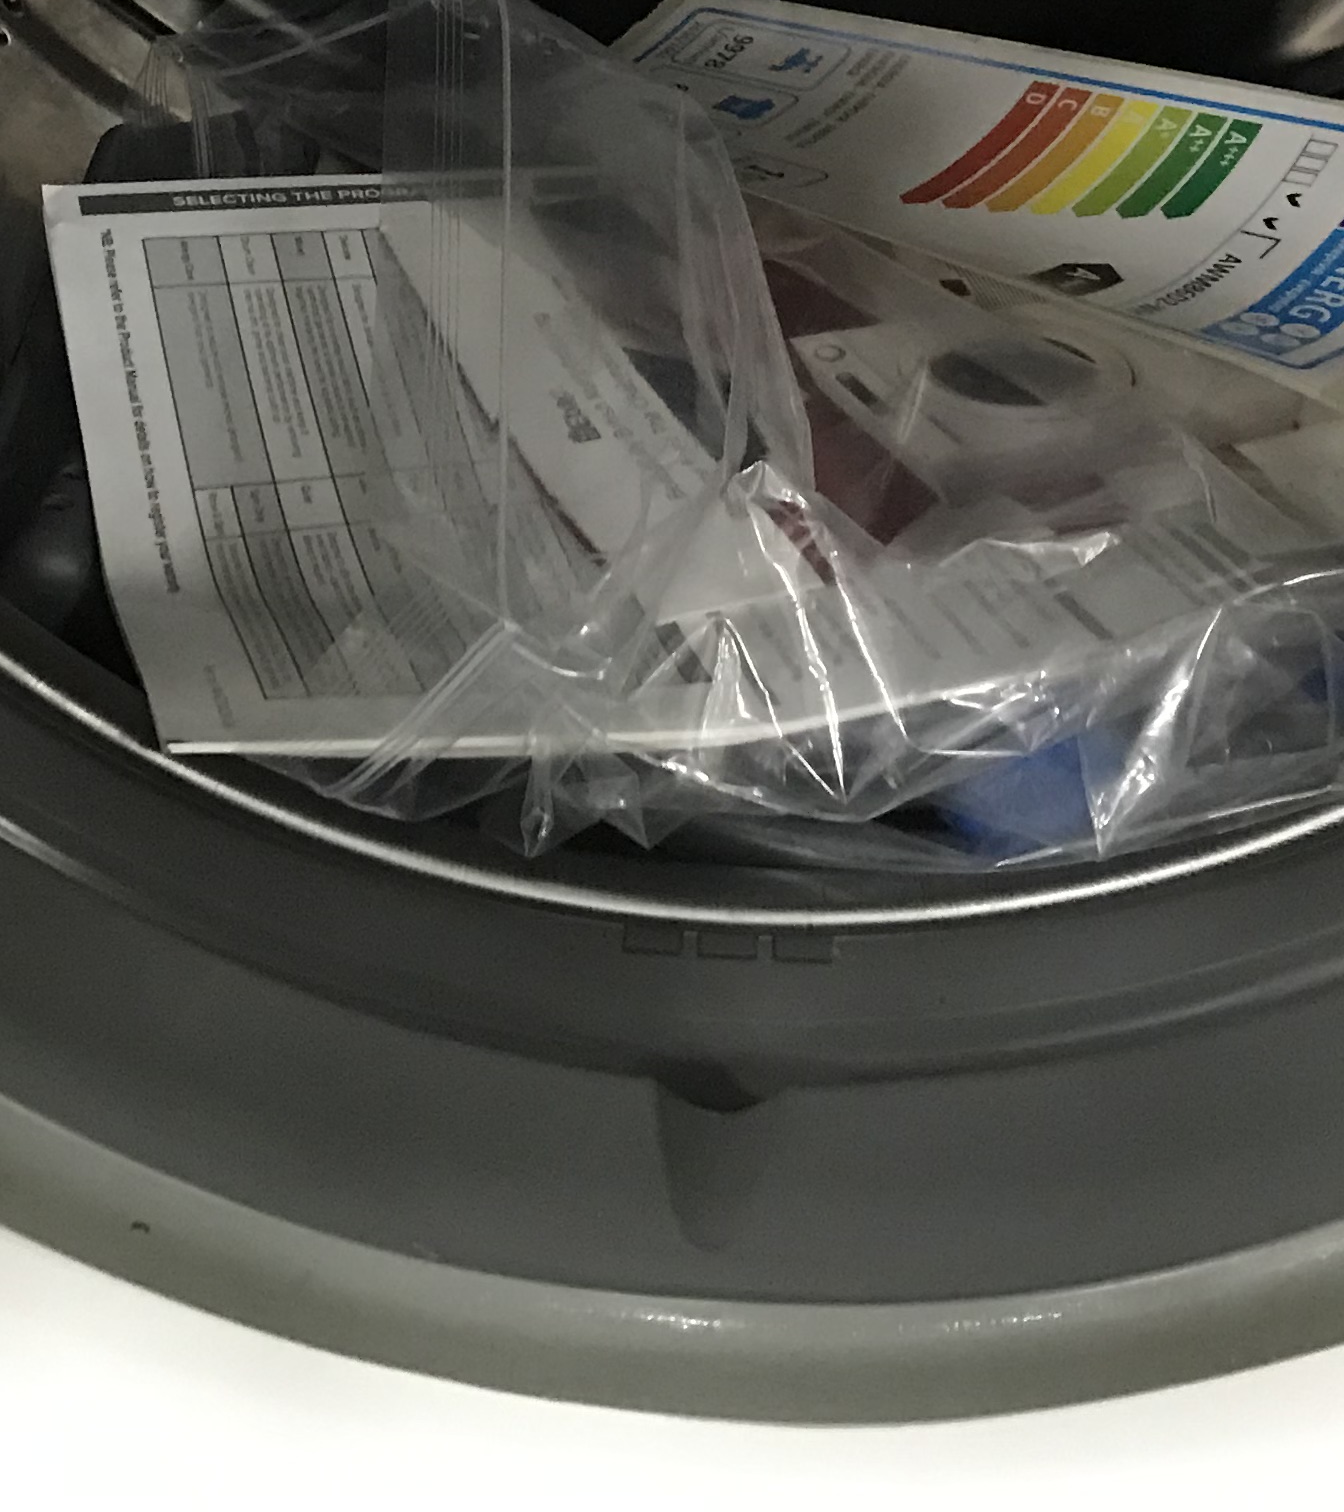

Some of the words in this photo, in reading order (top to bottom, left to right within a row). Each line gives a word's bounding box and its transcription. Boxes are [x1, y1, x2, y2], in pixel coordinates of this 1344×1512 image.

[1025, 92, 1047, 106] D
[1057, 98, 1078, 112] C
[1090, 106, 1111, 119] B
[1189, 123, 1213, 153] A++
[1219, 130, 1248, 167] A+++
[172, 190, 287, 208] SELECTING
[294, 188, 333, 204] THE
